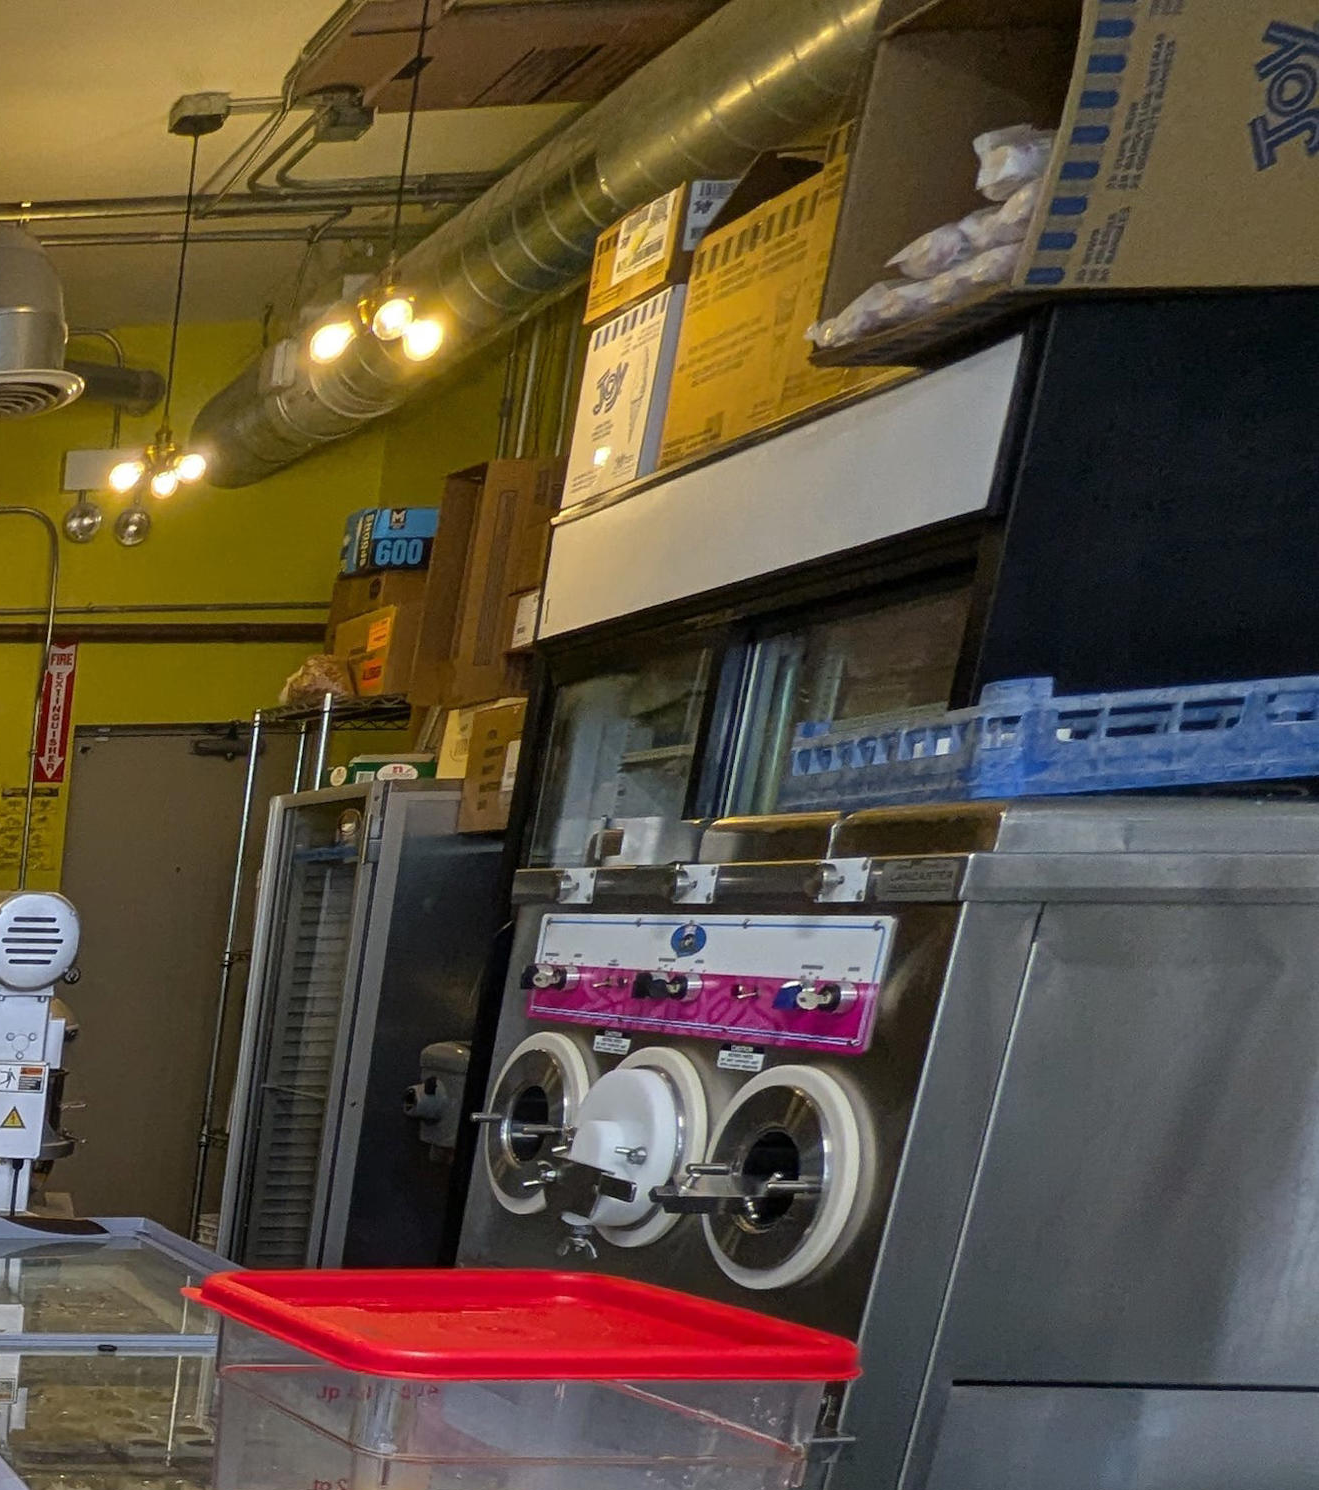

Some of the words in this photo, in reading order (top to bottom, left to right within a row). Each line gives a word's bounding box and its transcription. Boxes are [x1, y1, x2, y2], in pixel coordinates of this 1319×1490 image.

[1248, 20, 1319, 171] JOY
[375, 539, 424, 567] 600
[50, 653, 73, 666] FIRE
[46, 672, 63, 771] EXTINGUISHER
